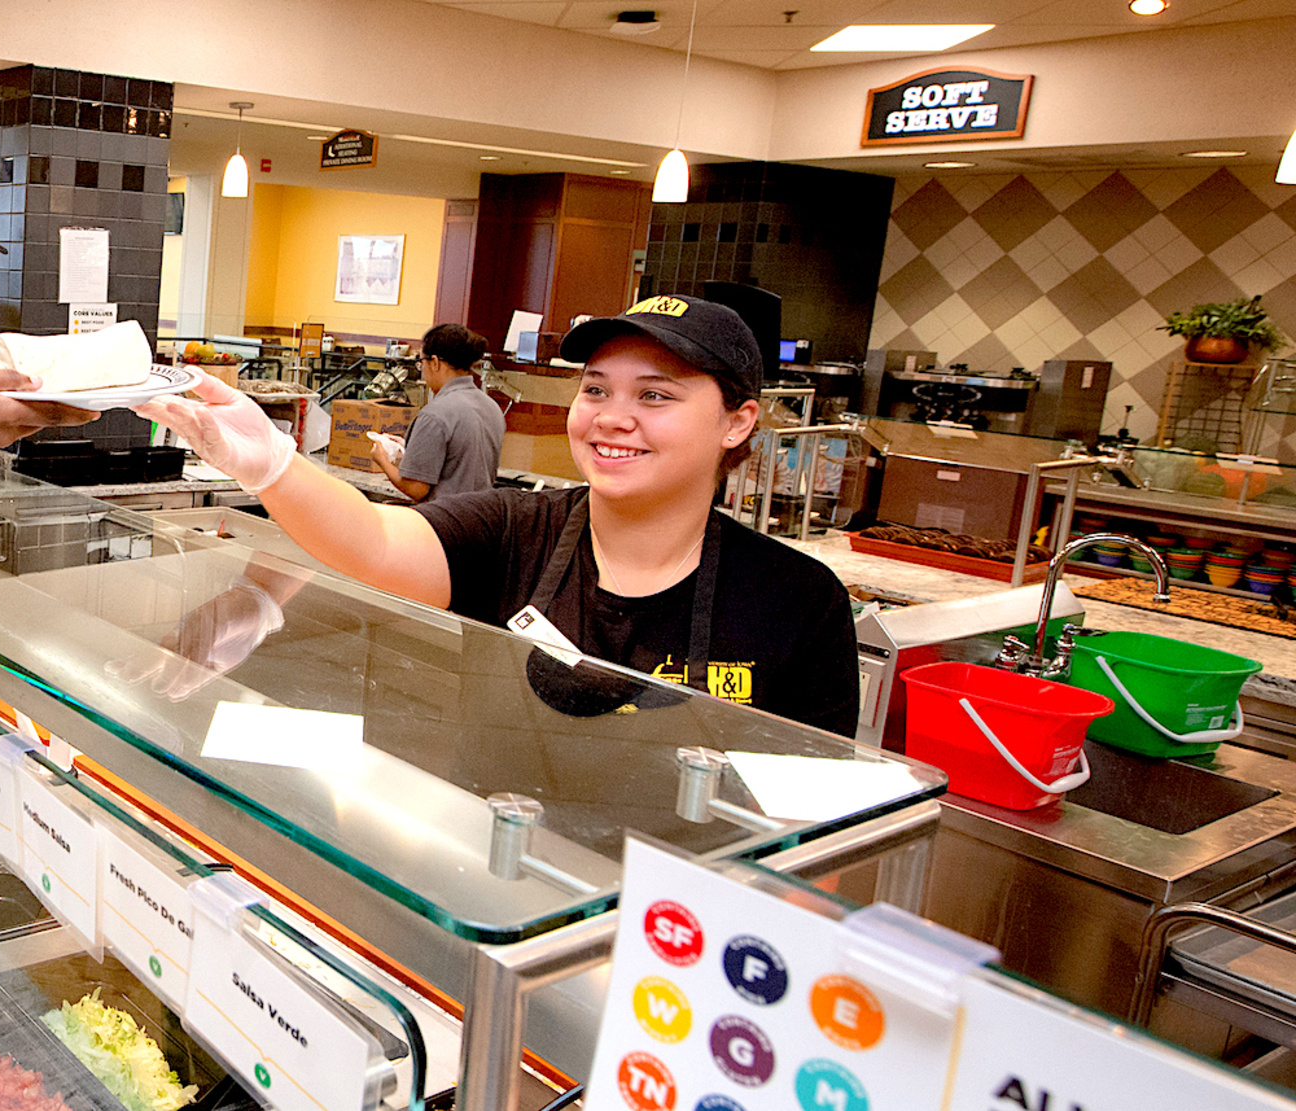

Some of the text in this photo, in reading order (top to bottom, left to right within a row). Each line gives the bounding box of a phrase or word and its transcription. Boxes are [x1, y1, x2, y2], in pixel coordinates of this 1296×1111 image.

[902, 81, 989, 109] SOFT
[885, 104, 998, 134] SERVE
[707, 665, 753, 698] H&D
[23, 800, 71, 854] Medium Salsa
[110, 862, 136, 894] Fresh
[137, 885, 159, 912] Pico
[161, 905, 175, 925] De
[653, 915, 696, 949] SF
[743, 954, 770, 982] F
[232, 972, 309, 1048] Salsa Verde
[647, 991, 680, 1026] W
[833, 996, 861, 1031] E
[728, 1036, 756, 1068] G
[626, 1065, 668, 1109] TN
[815, 1079, 849, 1111] M
